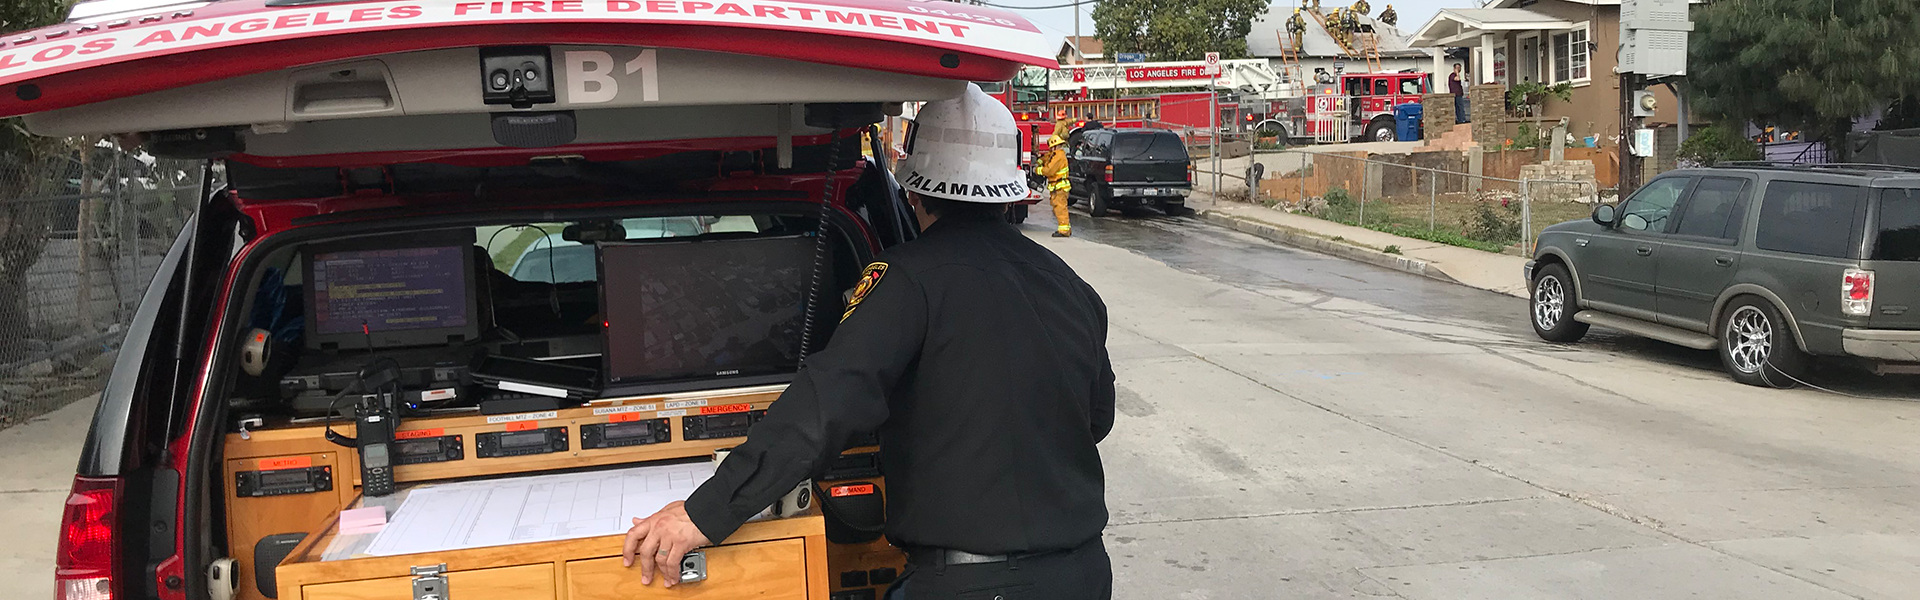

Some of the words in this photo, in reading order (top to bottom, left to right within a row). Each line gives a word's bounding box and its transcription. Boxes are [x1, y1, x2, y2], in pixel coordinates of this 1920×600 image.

[907, 5, 1017, 27] 04426
[0, 37, 118, 70] LOS
[133, 4, 424, 48] ANGELES
[452, 0, 587, 16] FIRE
[606, 0, 970, 38] DEPARTMENT
[563, 48, 660, 104] B1
[1130, 70, 1145, 79] LOS
[1147, 68, 1179, 78] ANGELES
[1181, 68, 1197, 77] FIRE
[905, 170, 1024, 197] TALAMANTES
[701, 404, 748, 414] EMERGENCY
[489, 414, 514, 422] FOOTHILL
[273, 459, 298, 467] METRO
